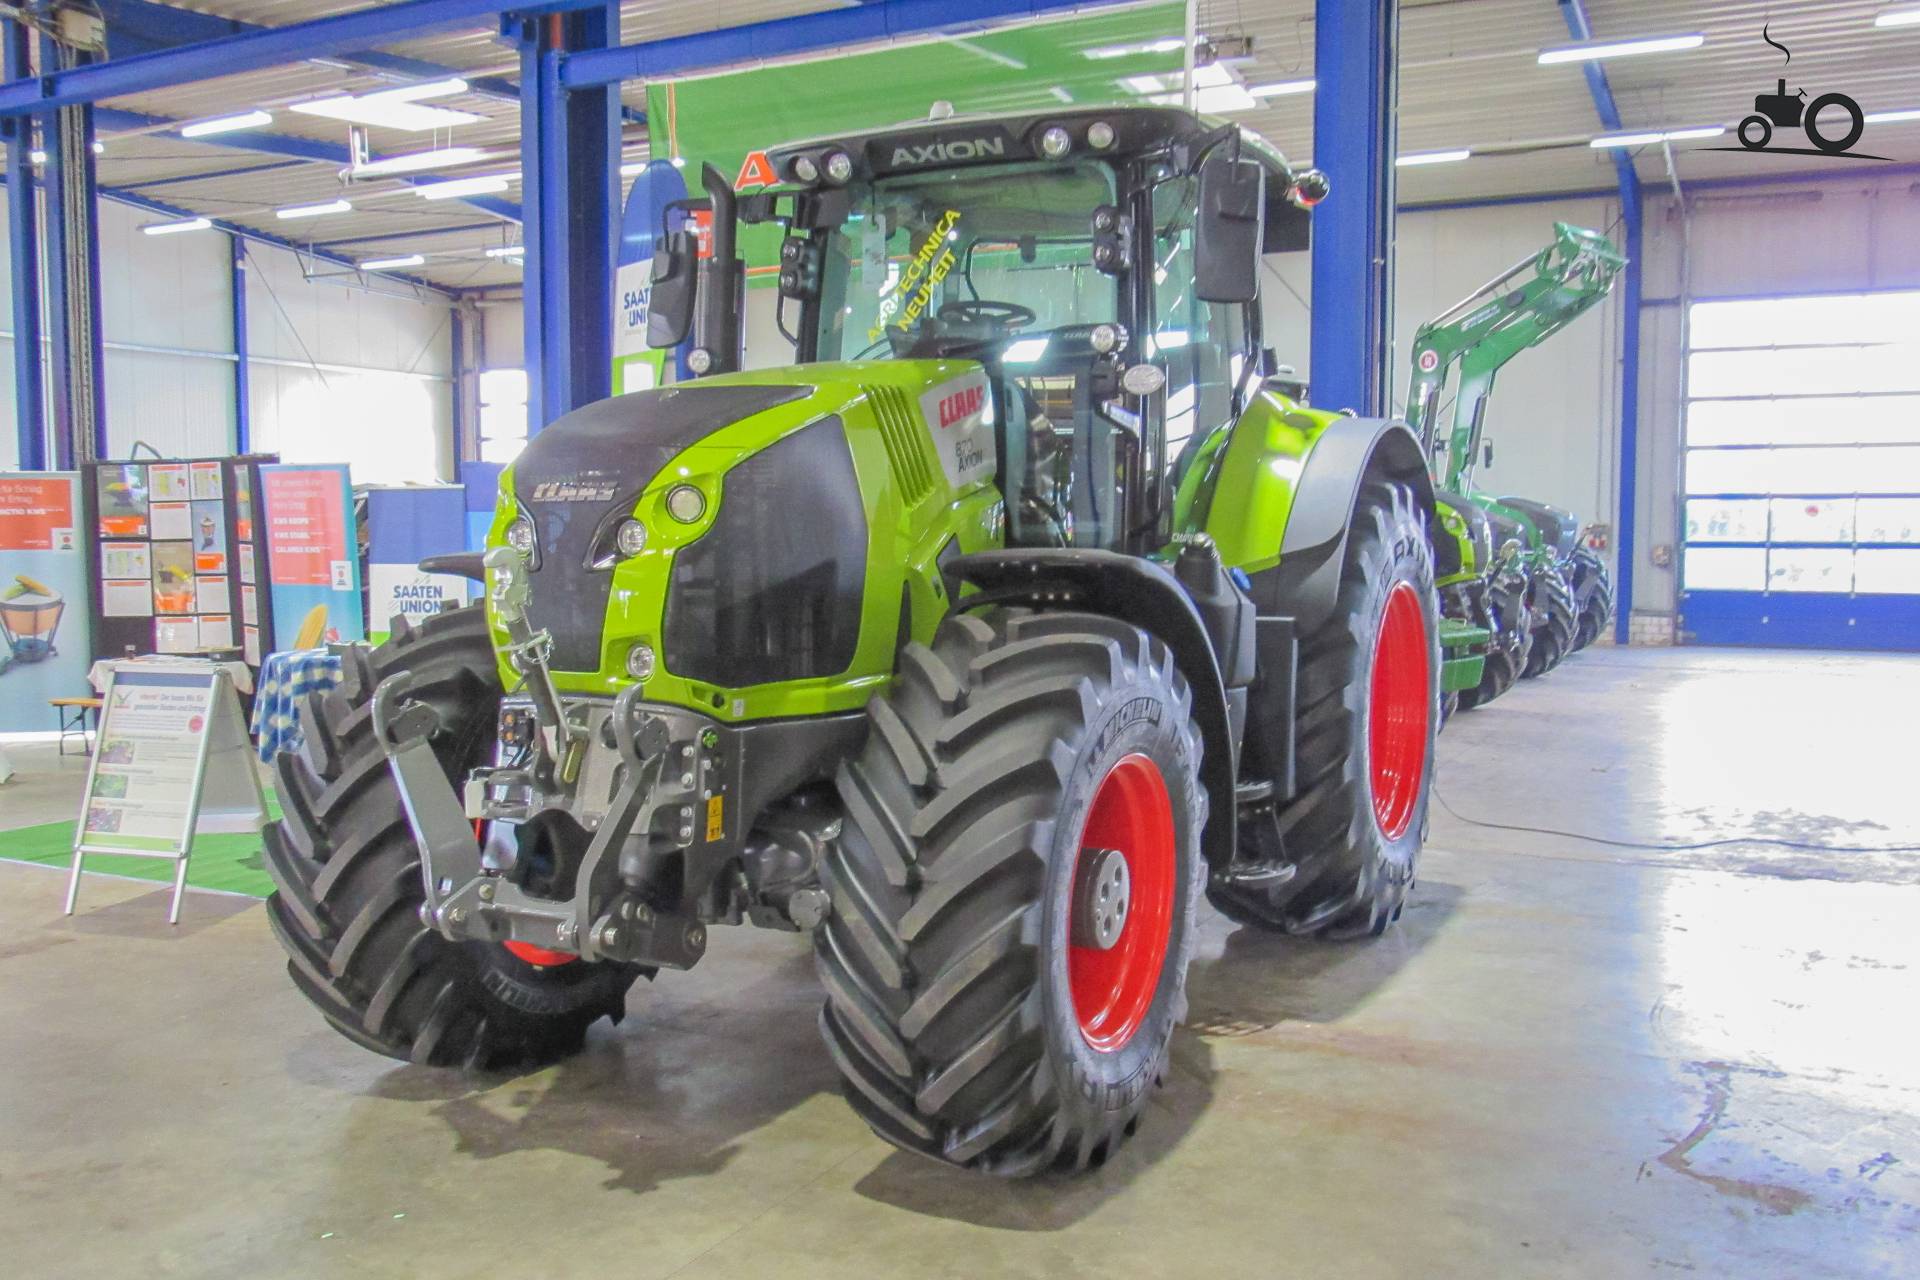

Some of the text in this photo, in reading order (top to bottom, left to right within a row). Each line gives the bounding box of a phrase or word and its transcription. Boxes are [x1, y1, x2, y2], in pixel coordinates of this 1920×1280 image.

[891, 136, 1005, 167] AXION
[624, 287, 650, 310] SAAT
[897, 248, 956, 332] NEUHEIT
[629, 307, 647, 327] UNI
[938, 385, 984, 429] CLAAS
[393, 585, 443, 598] SAATEN
[400, 600, 442, 613] UNION
